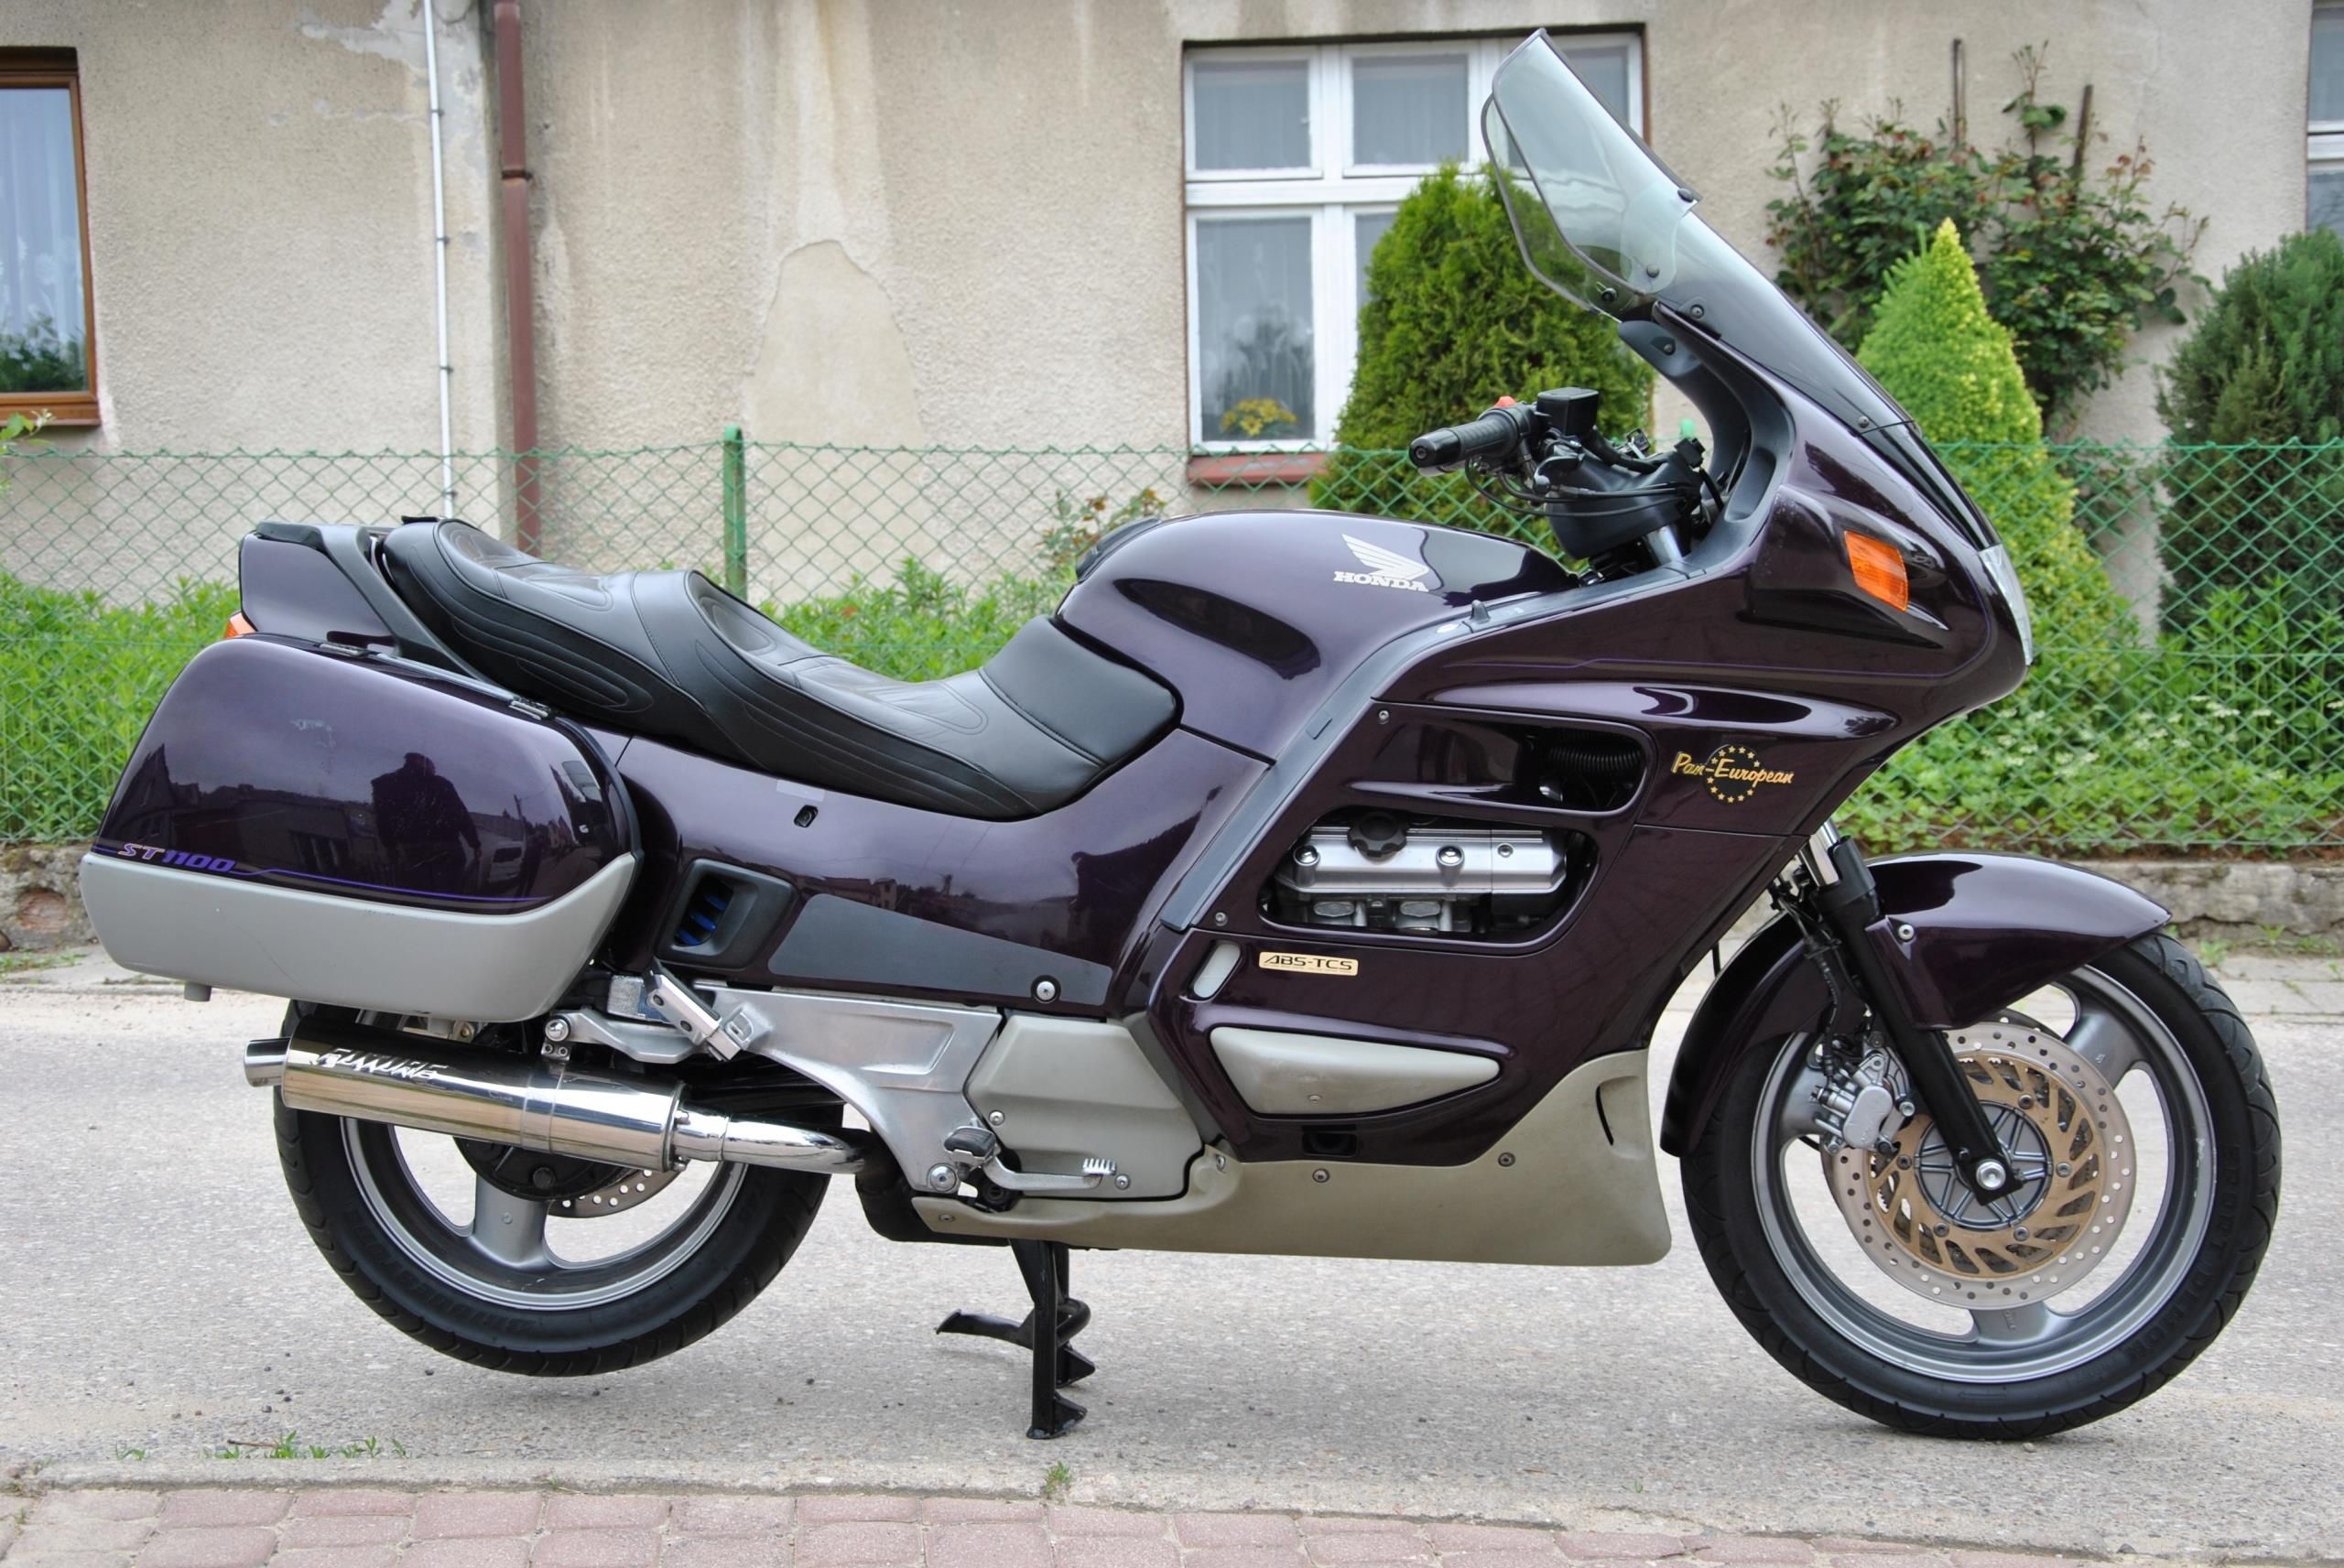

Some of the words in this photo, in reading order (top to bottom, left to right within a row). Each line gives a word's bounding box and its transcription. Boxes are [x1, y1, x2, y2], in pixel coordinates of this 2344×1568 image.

[1333, 571, 1429, 592] HONDA
[1671, 752, 1795, 788] Pan-European
[117, 843, 234, 871] ST1100
[1264, 955, 1352, 970] ABS-TCS
